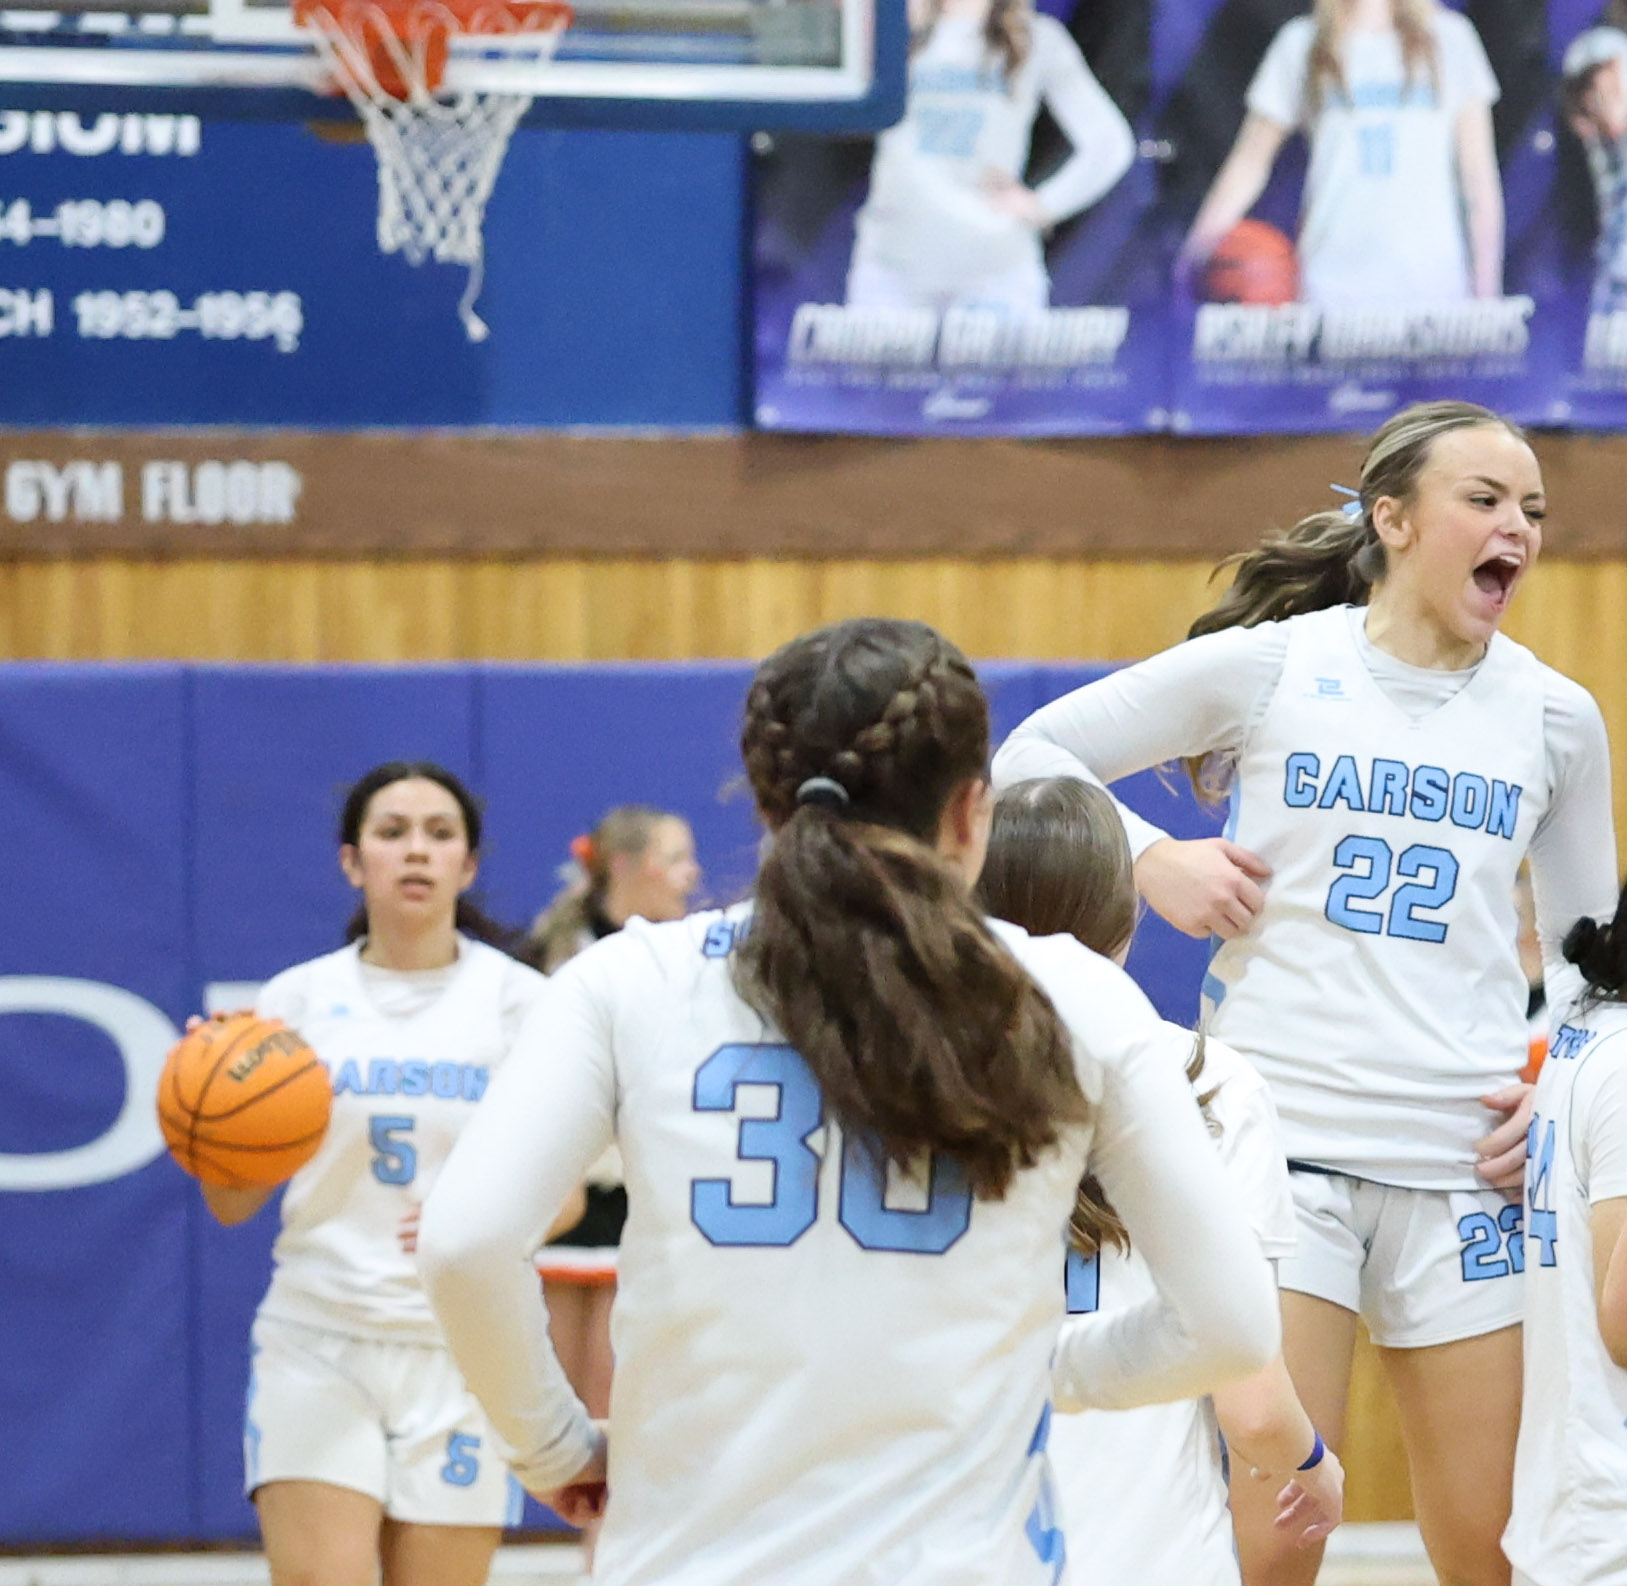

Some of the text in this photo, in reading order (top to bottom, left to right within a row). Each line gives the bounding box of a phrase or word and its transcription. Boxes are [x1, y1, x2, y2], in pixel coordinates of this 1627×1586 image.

[5, 460, 304, 525] GYM FLOOR
[1284, 752, 1521, 840] CARSON
[1325, 835, 1459, 944] 22
[327, 1057, 491, 1103] ARSON
[369, 1114, 416, 1186] 5
[691, 1043, 974, 1256] 30
[443, 1432, 482, 1487] 5
